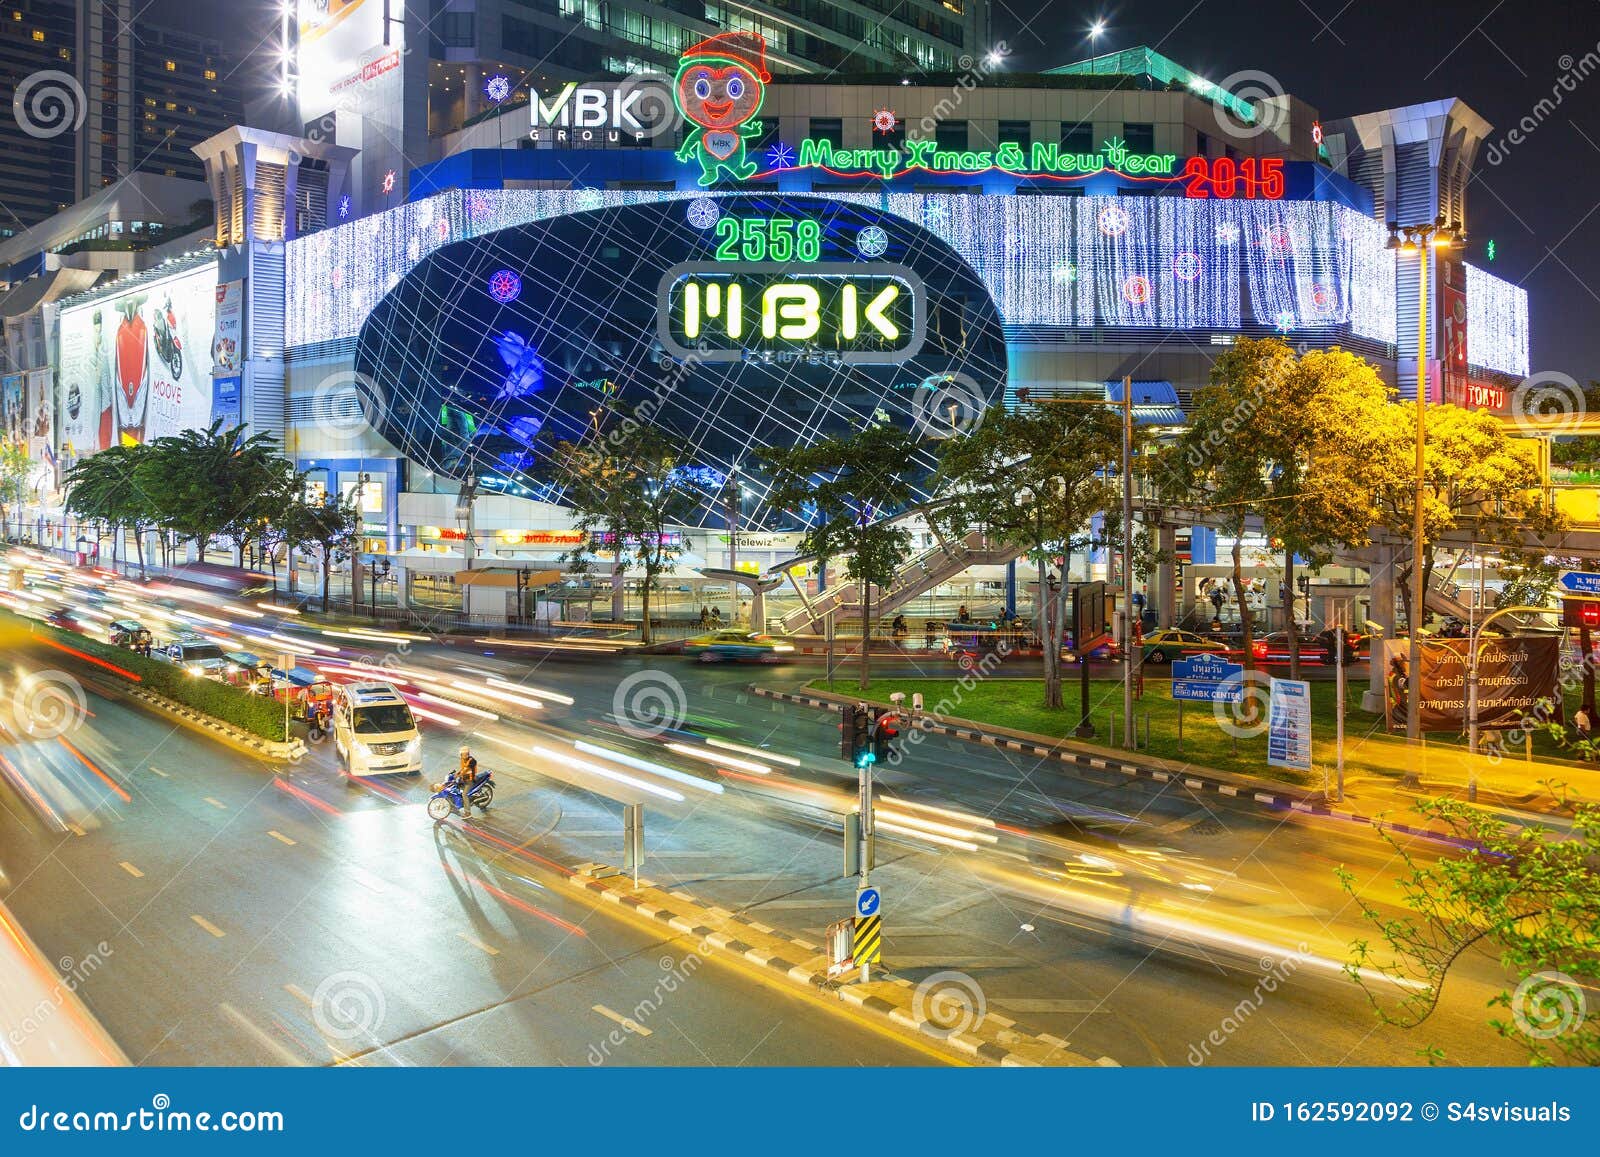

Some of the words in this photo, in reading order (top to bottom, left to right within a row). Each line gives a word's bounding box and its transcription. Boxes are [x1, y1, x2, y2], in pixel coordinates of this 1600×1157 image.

[530, 82, 643, 128] MBK
[529, 129, 644, 142] GROUP
[799, 138, 899, 180] Merry
[906, 140, 992, 171] X'mas
[995, 142, 1027, 171] &
[1031, 142, 1104, 173] New
[1107, 146, 1176, 173] Year
[1185, 155, 1285, 200] 2015
[715, 217, 821, 262] 2558
[683, 282, 900, 340] MBK
[1467, 385, 1503, 409] TOKYU
[736, 537, 772, 547] Telewiz
